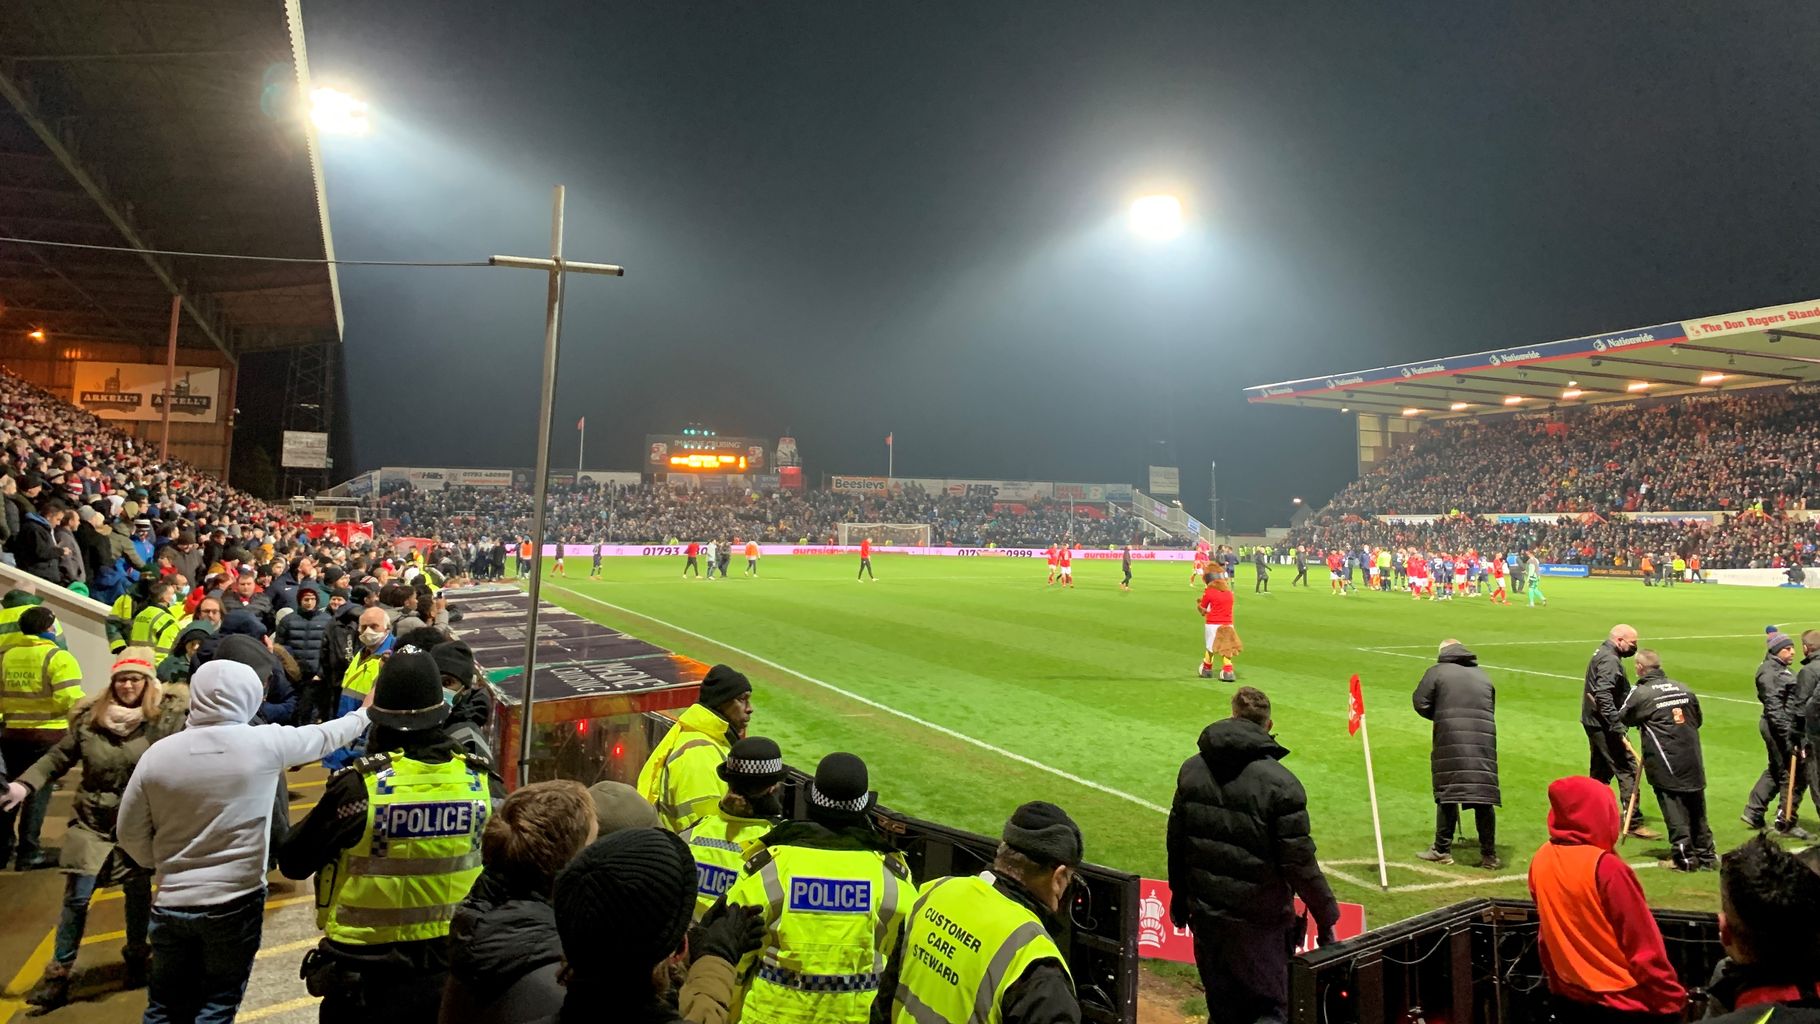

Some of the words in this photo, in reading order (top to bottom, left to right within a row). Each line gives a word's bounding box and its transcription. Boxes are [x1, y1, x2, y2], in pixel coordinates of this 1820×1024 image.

[1701, 324, 1722, 333] The
[1723, 320, 1745, 330] Don
[1746, 314, 1785, 326] Rogers
[1787, 307, 1820, 320] Stand
[1607, 333, 1655, 348] Nationwide
[1501, 350, 1541, 363] Nationwide
[1411, 364, 1446, 375] Nationwide
[83, 393, 138, 404] ARKELL'S
[154, 396, 208, 406] AKELL'S
[966, 483, 999, 497] Hills
[643, 547, 679, 556] 01793
[391, 806, 469, 834] POLICE
[697, 867, 736, 894] OLICE
[794, 882, 868, 908] POLICE
[925, 907, 982, 954] CUSTOMER
[927, 932, 957, 960] CARE
[912, 944, 959, 986] STEWARD
